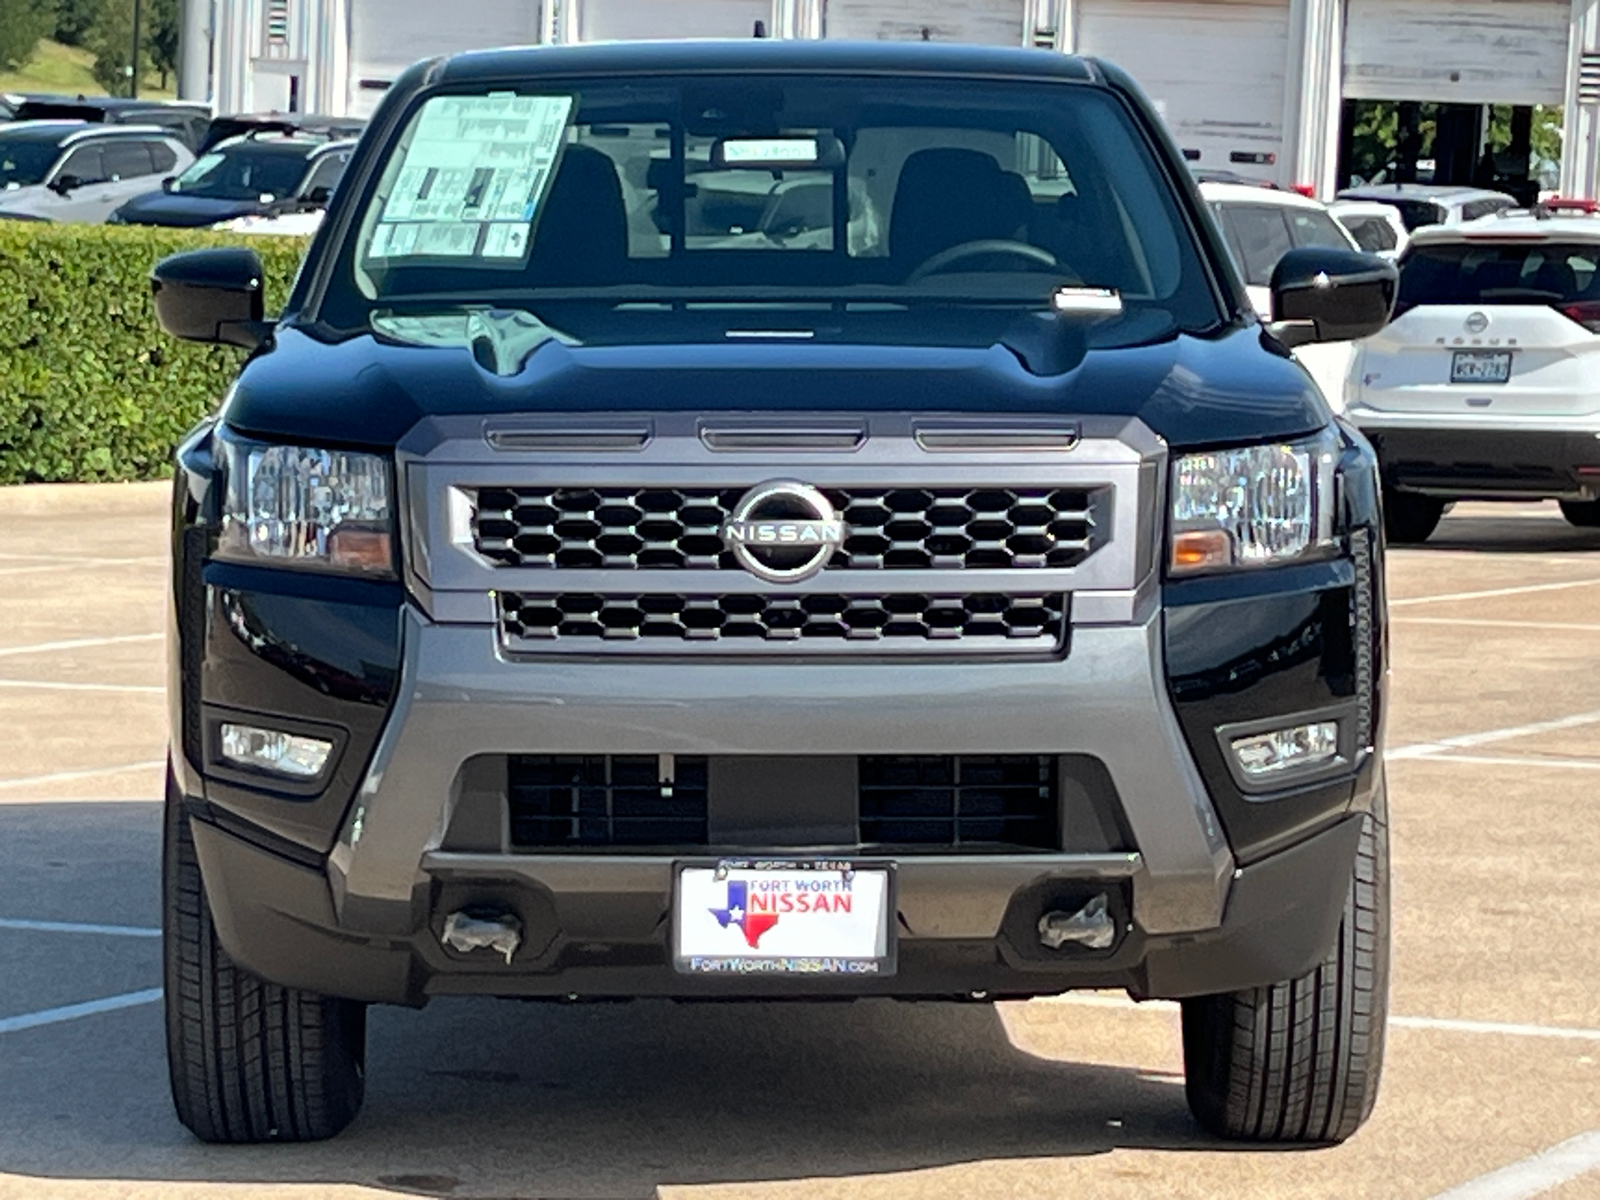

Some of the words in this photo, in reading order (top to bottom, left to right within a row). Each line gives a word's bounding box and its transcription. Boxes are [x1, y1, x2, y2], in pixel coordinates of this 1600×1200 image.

[726, 525, 841, 542] NISSAN
[750, 880, 791, 892] FORT
[795, 880, 853, 892] WORTH
[750, 893, 853, 914] NISSAN
